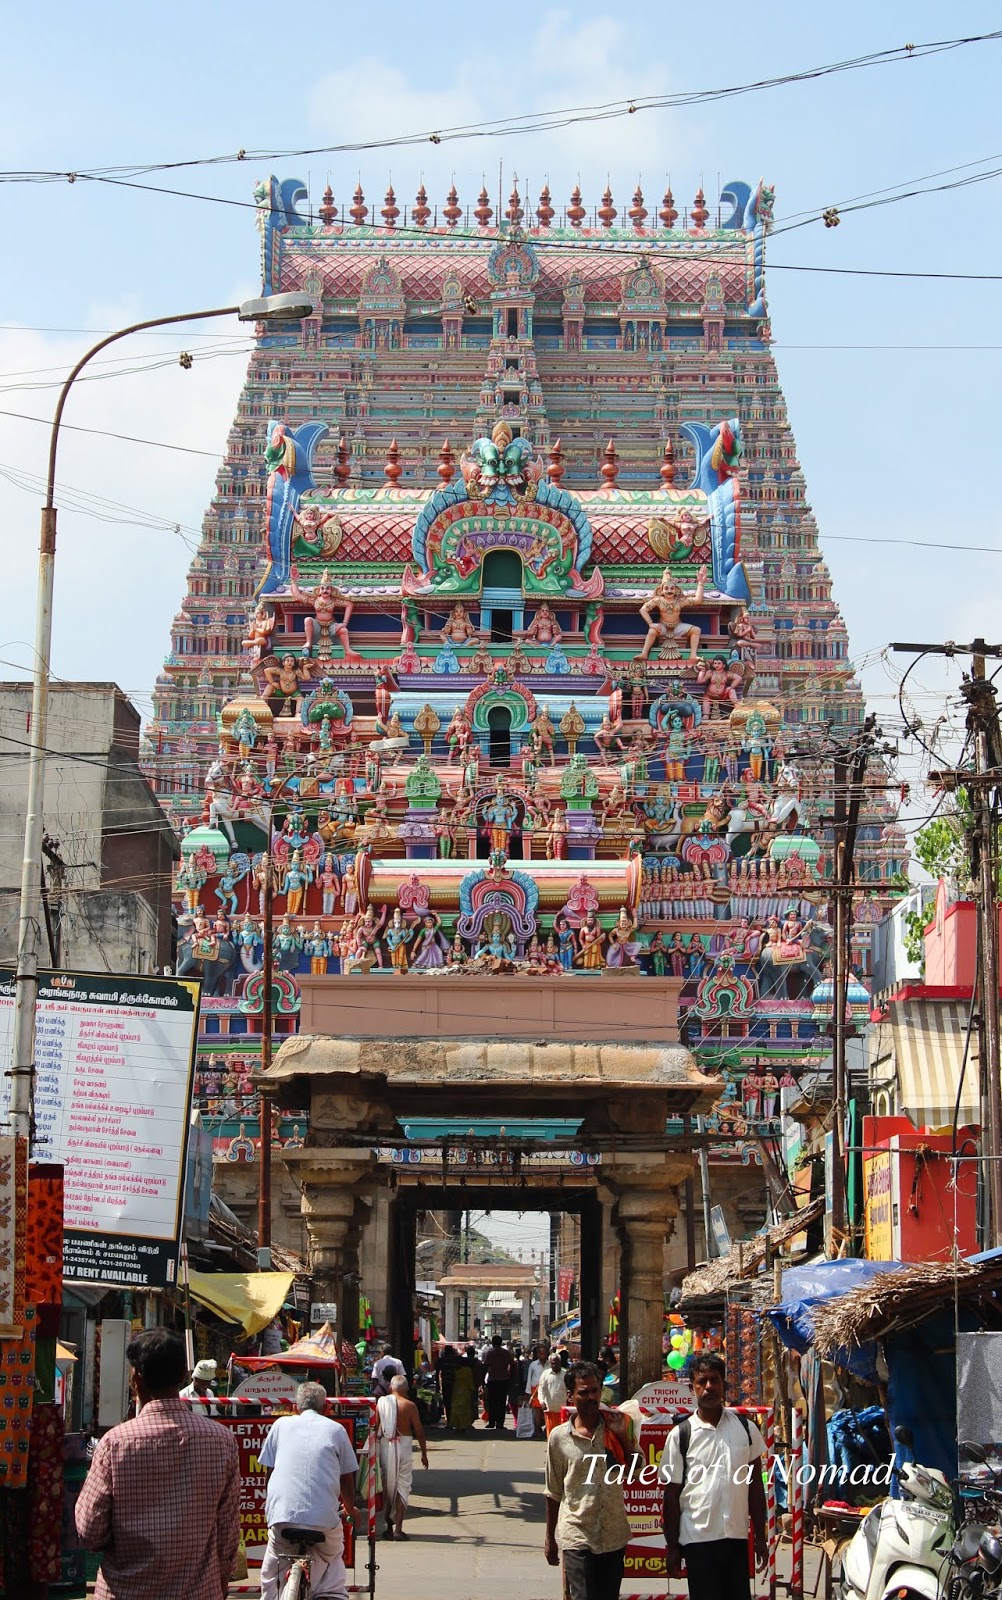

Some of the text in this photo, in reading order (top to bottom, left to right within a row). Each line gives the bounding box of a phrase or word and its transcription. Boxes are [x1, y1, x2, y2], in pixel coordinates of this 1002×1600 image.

[88, 990, 118, 1002] சுவாமி
[119, 992, 178, 1006] திருக்கோயில்
[77, 1266, 100, 1279] RENT
[101, 1269, 149, 1284] AVAILABLE
[663, 1397, 693, 1405] POLICE
